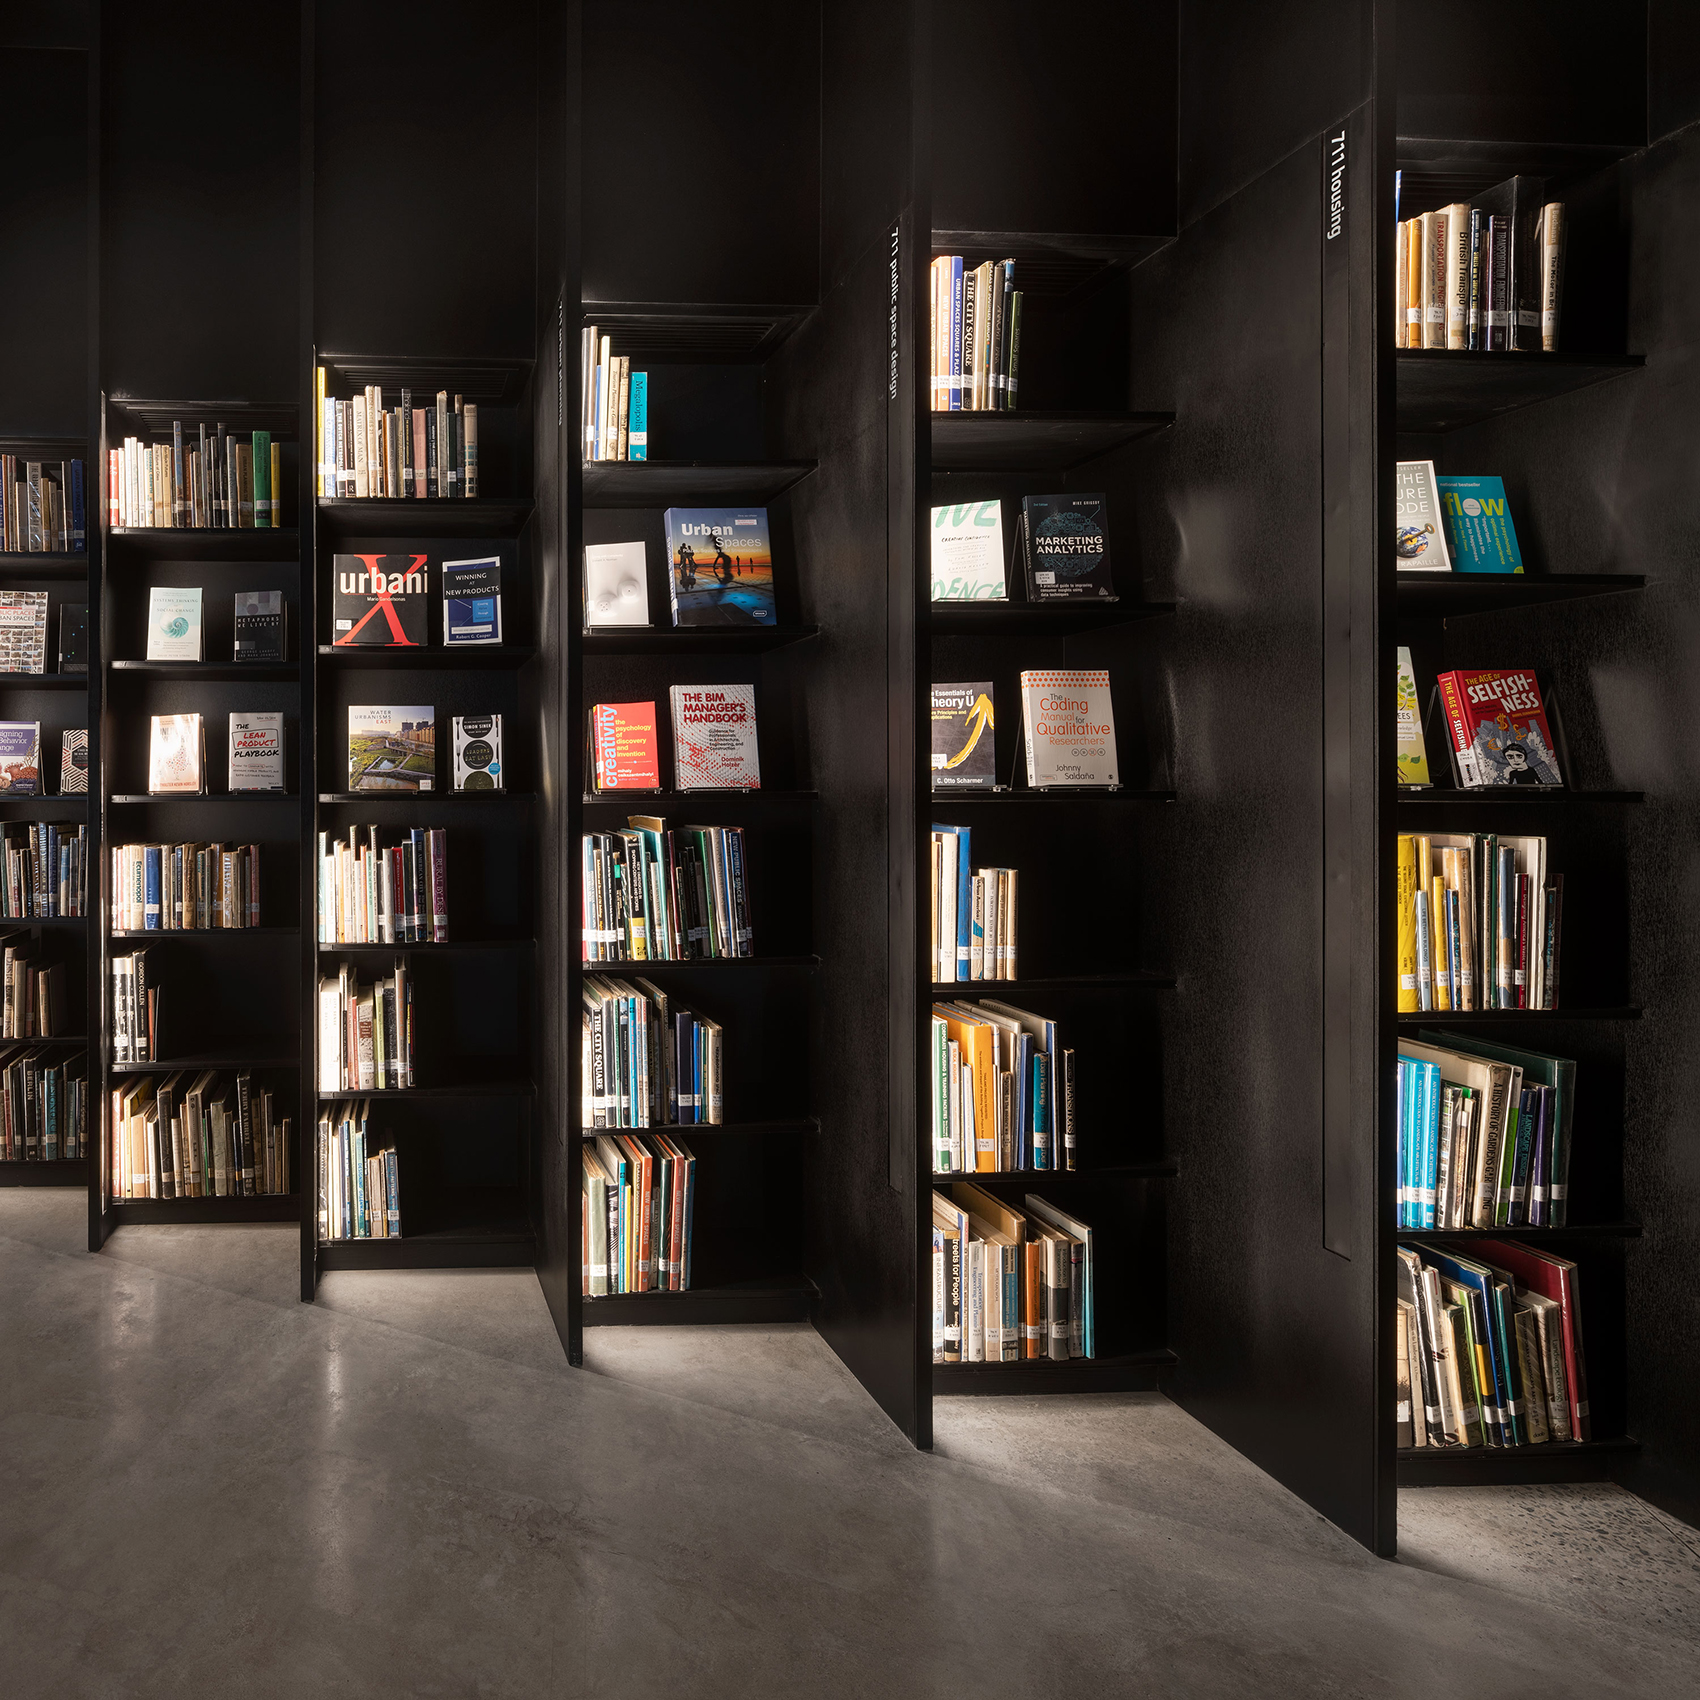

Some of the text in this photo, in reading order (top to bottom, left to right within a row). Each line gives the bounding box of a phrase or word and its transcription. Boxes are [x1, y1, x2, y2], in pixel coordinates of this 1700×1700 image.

[1326, 130, 1346, 240] 711 housing
[1550, 210, 1560, 244] Buchanan
[1456, 232, 1468, 305] British Transpo
[1494, 232, 1507, 311] TRANSPORTATION ENGINEERIN
[890, 227, 899, 400] 711 public space design
[965, 280, 974, 367] THE CITY SQUARE
[1012, 328, 1020, 353] Squares
[634, 380, 643, 431] Megalopolis
[1397, 472, 1424, 484] THE
[1443, 492, 1504, 517] flow
[681, 523, 734, 536] Urban
[715, 536, 762, 549] Spaces
[1035, 536, 1104, 545] MARKETING
[1490, 518, 1506, 565] optimal experience
[1500, 526, 1512, 556] psychology
[1036, 544, 1104, 554] ANALYTICS
[1401, 559, 1438, 567] RAPAILLE
[455, 572, 487, 581] WINNING
[462, 586, 500, 596] PRODUCTS
[1464, 678, 1479, 686] THE
[1478, 674, 1494, 683] AGE
[1467, 673, 1534, 704] SELFISH-
[682, 693, 725, 702] THE BIM
[932, 696, 974, 710] heory U
[1501, 692, 1540, 714] NESS
[684, 703, 746, 713] MANAGER'S
[1040, 698, 1089, 714] Coding
[684, 713, 748, 723] HANDBOOK
[1040, 712, 1084, 724] Manual for
[1444, 682, 1468, 752] THE AGE OF SELFISHN
[243, 732, 266, 740] LEAN
[1036, 722, 1111, 736] Qualitative
[236, 739, 276, 748] PRODUCT
[600, 705, 618, 787] creativity
[1049, 736, 1105, 746] Researchers
[234, 750, 280, 758] PLAYBOOK
[1055, 764, 1082, 773] Johnny
[1064, 772, 1095, 780] Saldaña
[436, 886, 444, 896] BY
[594, 1054, 604, 1090] SQUARE
[1037, 1078, 1048, 1105] Planning
[1066, 1082, 1075, 1134] TRANSITIONS
[1490, 1090, 1502, 1122] HISTORY
[1489, 1122, 1500, 1131] OF
[1486, 1132, 1498, 1166] GARDENS
[1519, 1114, 1533, 1177] LANDSCAPE DESIGN
[952, 1277, 960, 1306] People
[1552, 1339, 1564, 1403] Landscape Ecology
